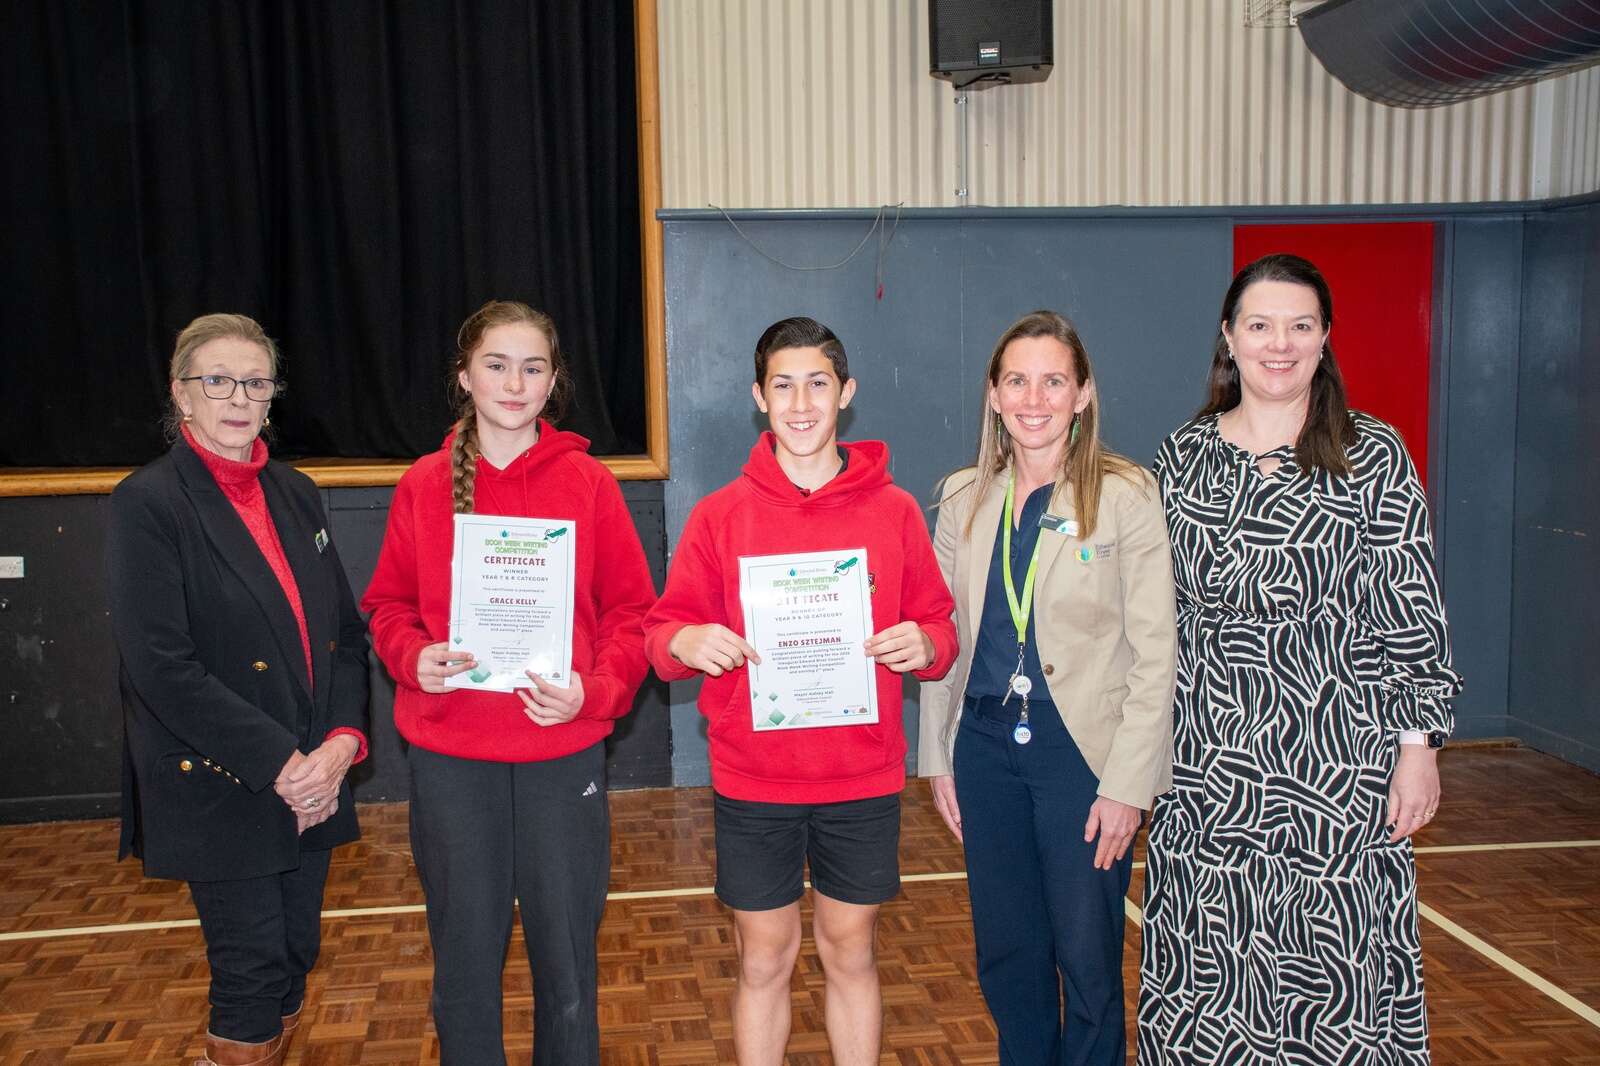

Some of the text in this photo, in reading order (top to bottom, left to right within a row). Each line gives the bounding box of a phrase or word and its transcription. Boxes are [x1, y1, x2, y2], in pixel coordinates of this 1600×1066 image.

[484, 556, 546, 566] CERTIFICATE
[773, 579, 792, 588] BOOK
[800, 636, 841, 646] SZTEJMAN
